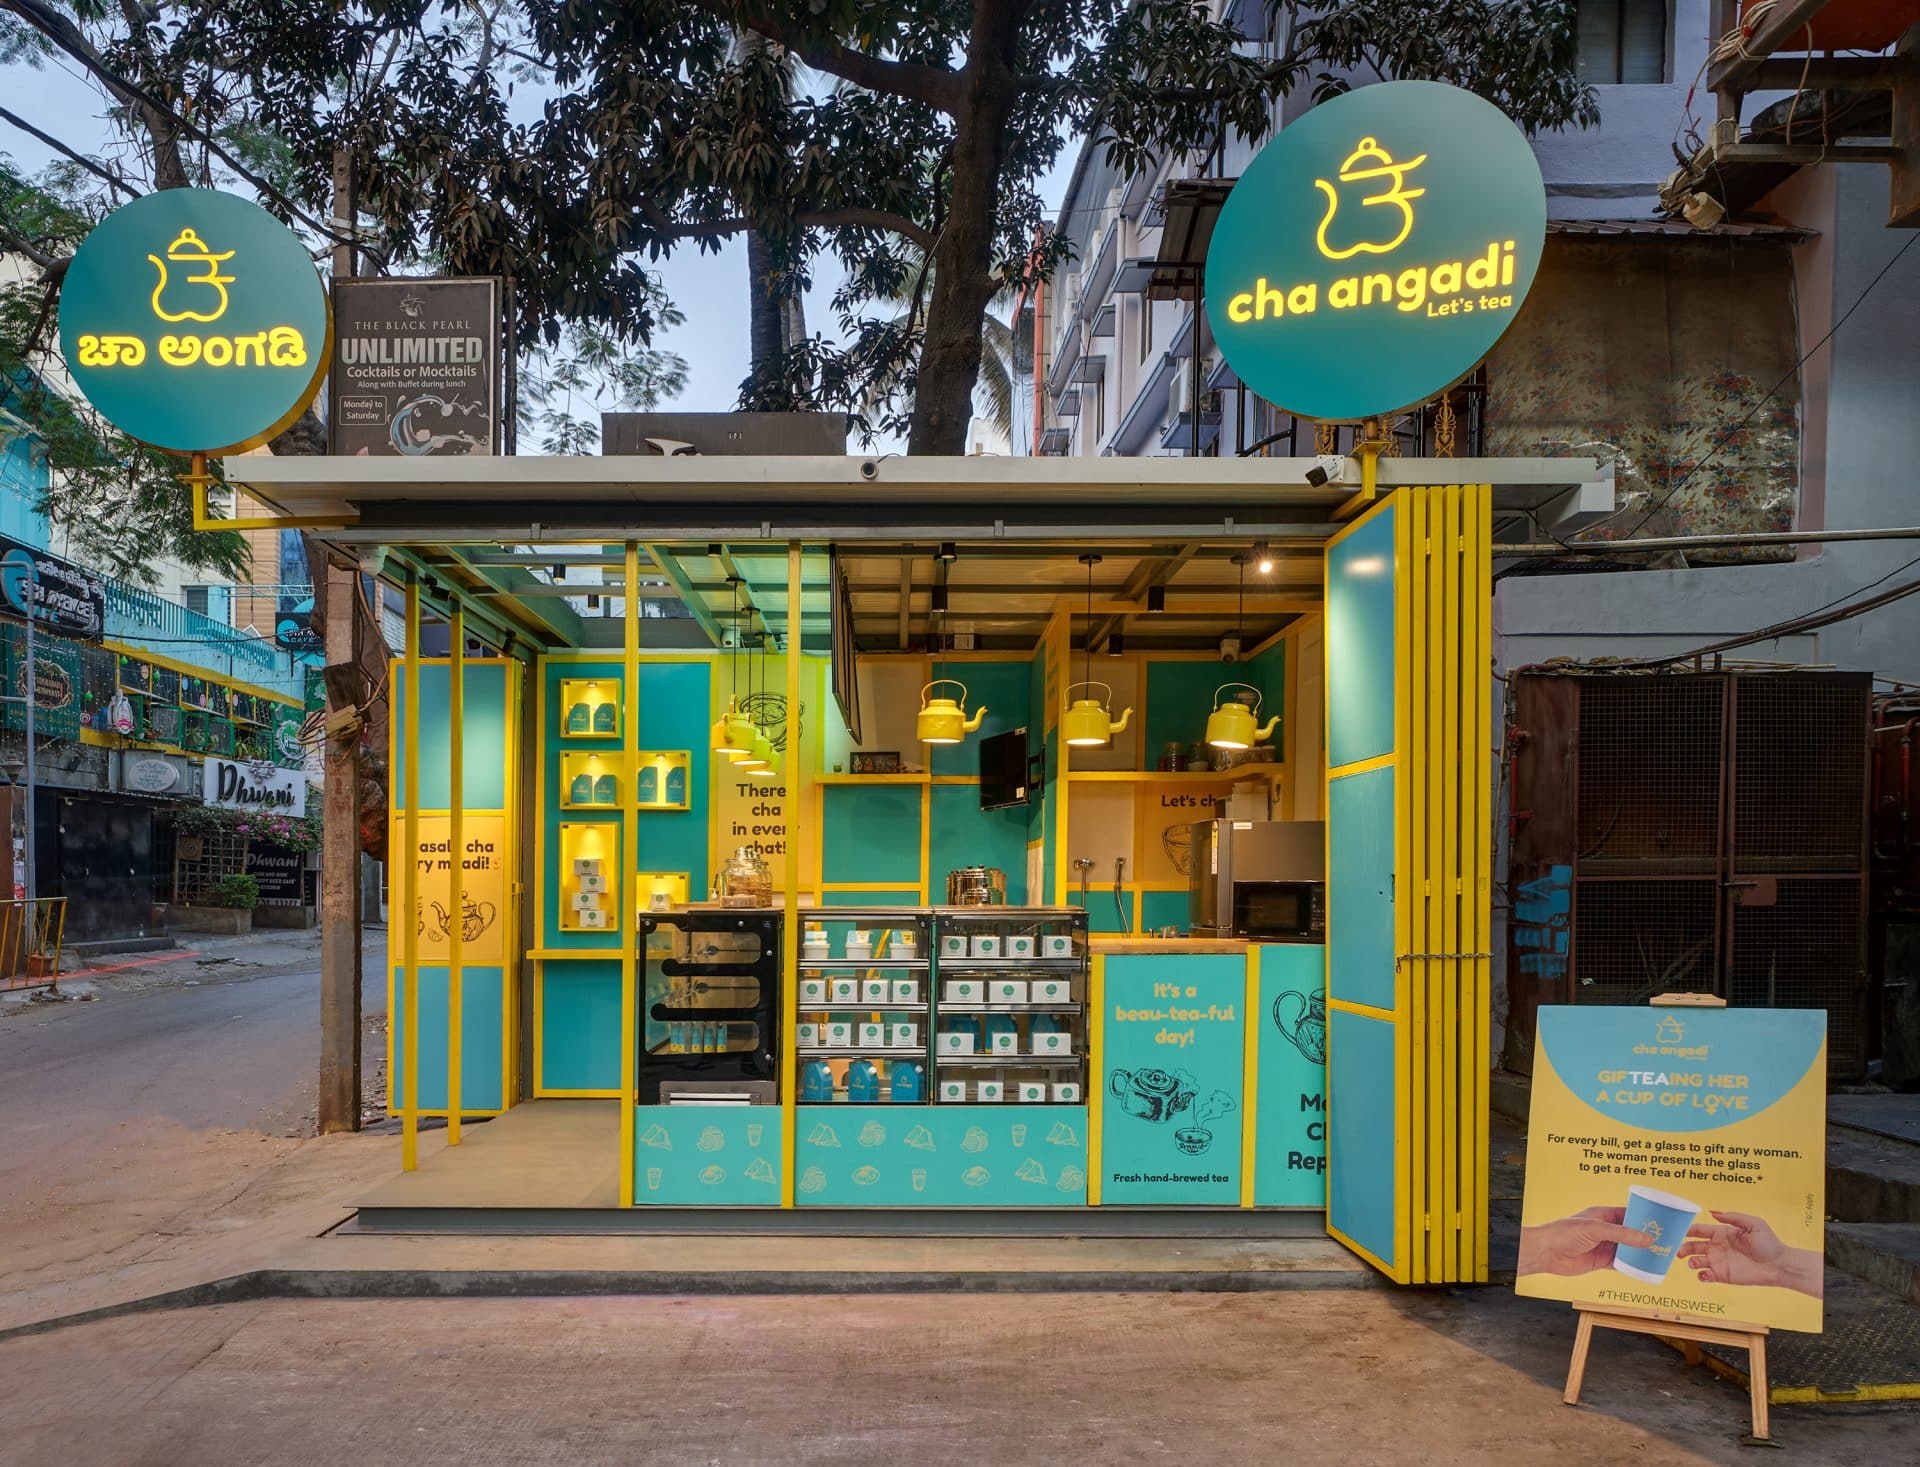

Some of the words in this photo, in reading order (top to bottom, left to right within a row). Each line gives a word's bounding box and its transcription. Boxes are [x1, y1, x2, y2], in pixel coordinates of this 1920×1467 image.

[1228, 279, 1316, 323] cha
[1328, 240, 1515, 312] angadi
[1427, 298, 1473, 317] Let's
[1479, 295, 1512, 310] tea
[355, 321, 378, 330] THE
[386, 321, 426, 330] BLACK
[433, 320, 471, 329] PEARL
[158, 326, 307, 367] ಅಂಗಡಿ
[341, 337, 483, 364] UNLIMITED
[347, 366, 400, 378] Cocktails
[404, 369, 416, 378] or
[419, 365, 477, 378] Mocktails
[358, 380, 379, 388] Along
[380, 380, 396, 388] with
[398, 380, 420, 388] Buffet
[421, 380, 444, 389] during
[446, 380, 466, 388] lunch
[344, 401, 373, 410] Monday
[346, 412, 379, 421] Saturday
[218, 762, 296, 807] Dhwani
[1162, 794, 1196, 807] Let's
[752, 802, 781, 816] cha
[732, 821, 747, 836] in
[752, 825, 800, 836] ever
[466, 838, 494, 852] cha
[438, 856, 490, 870] madi!
[1154, 983, 1180, 998] It's
[1185, 986, 1197, 998] a
[1115, 1005, 1235, 1021] beau-tea-ful
[1154, 1028, 1195, 1047] day!
[1632, 1043, 1657, 1054] cha
[1660, 1045, 1708, 1057] angadi
[1598, 1070, 1704, 1087] GIFTEAING
[1708, 1074, 1748, 1088] HER
[1596, 1090, 1610, 1102] A
[1615, 1090, 1655, 1104] CUP
[1660, 1092, 1688, 1106] OF
[1692, 1094, 1749, 1115] LOVE
[1547, 1134, 1565, 1143] For
[1568, 1136, 1598, 1147] every
[1600, 1136, 1620, 1148] bill,
[1623, 1140, 1642, 1150] get
[1654, 1141, 1686, 1152] glass
[1690, 1143, 1700, 1152] to
[1704, 1144, 1724, 1154] gift
[1728, 1146, 1750, 1157] any
[1753, 1148, 1802, 1158] woman.
[1288, 1152, 1326, 1175] Rep
[1583, 1149, 1604, 1158] The
[1606, 1152, 1648, 1162] woman
[1650, 1155, 1702, 1166] presents
[1705, 1158, 1724, 1168] the
[1728, 1160, 1760, 1170] glass
[1114, 1174, 1142, 1183] Fresh
[1144, 1173, 1210, 1183] hand-brewed
[1212, 1174, 1229, 1183] tea
[1580, 1162, 1590, 1171] to
[1593, 1164, 1612, 1174] get
[1614, 1166, 1620, 1174] a
[1624, 1165, 1647, 1176] free
[1650, 1167, 1670, 1178] Tea
[1674, 1169, 1686, 1178] of
[1690, 1170, 1709, 1180] her
[1598, 1290, 1725, 1314] #THEWOMENSWEEK
